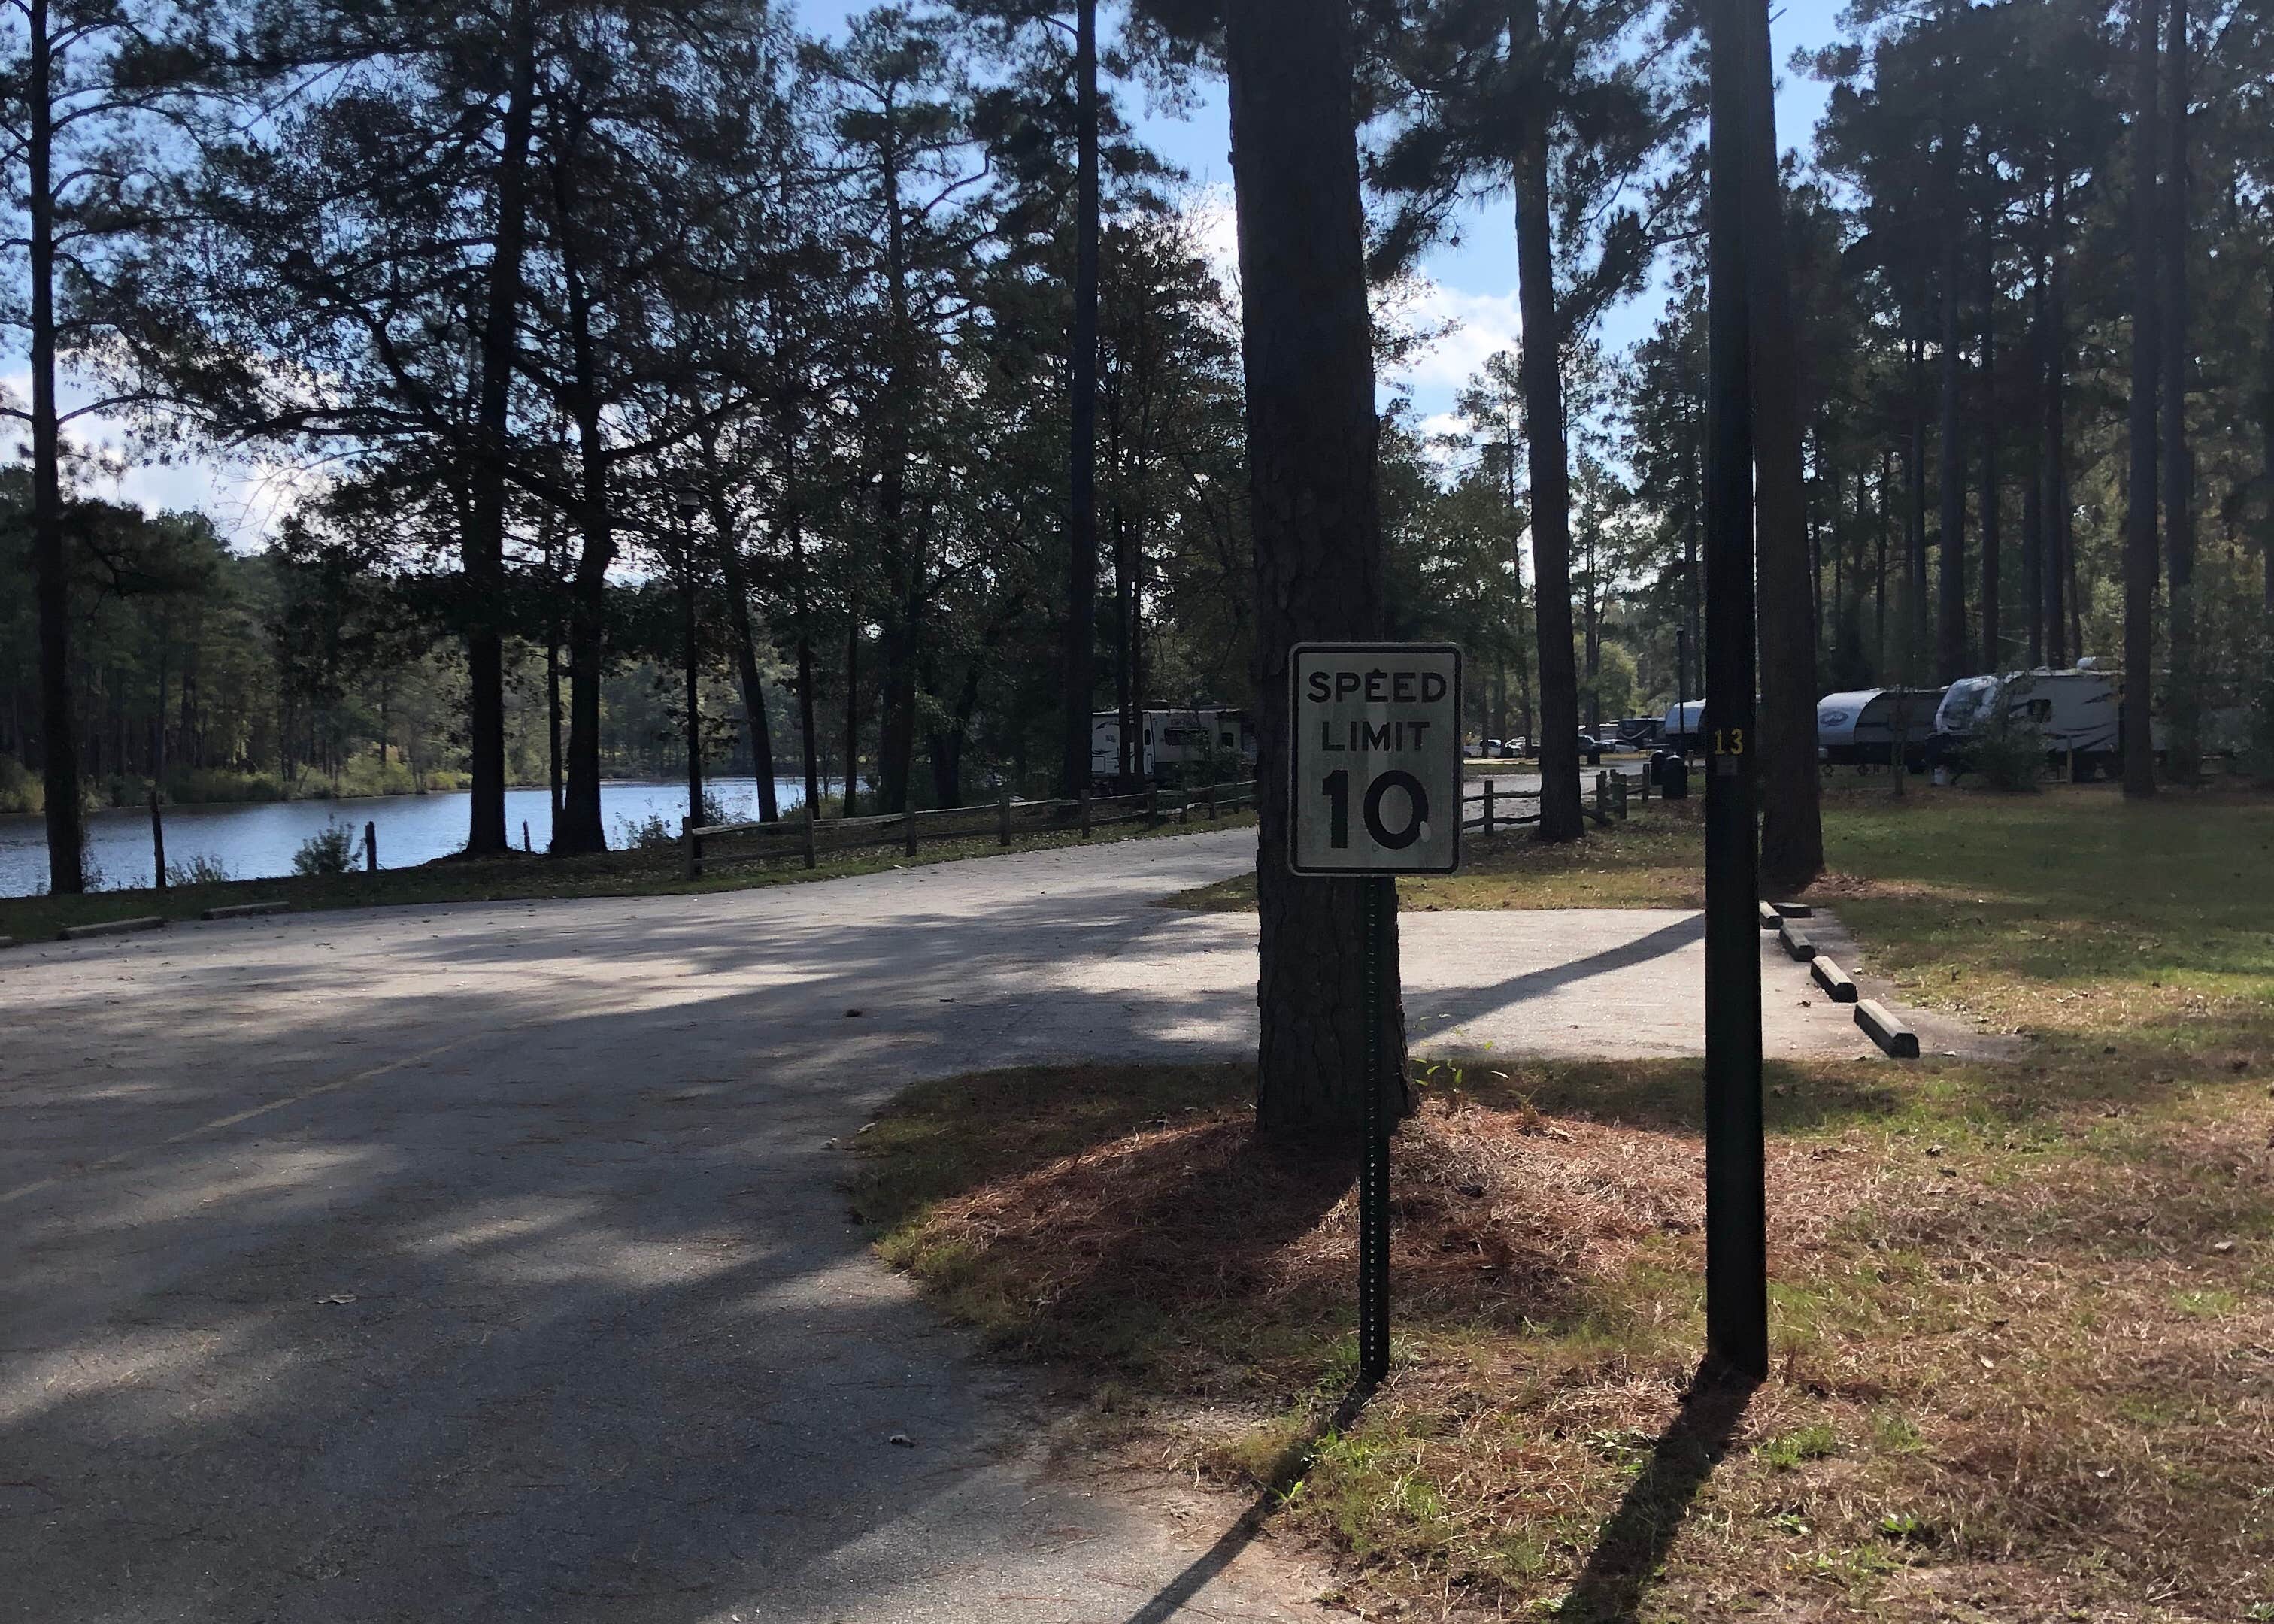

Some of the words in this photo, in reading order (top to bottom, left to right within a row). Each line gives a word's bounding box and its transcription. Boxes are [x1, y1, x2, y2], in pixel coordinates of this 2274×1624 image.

[1307, 671, 1447, 703] SPEED
[1322, 721, 1430, 752] LIMIT
[1715, 728, 1743, 755] 13
[1322, 770, 1429, 850] 10
